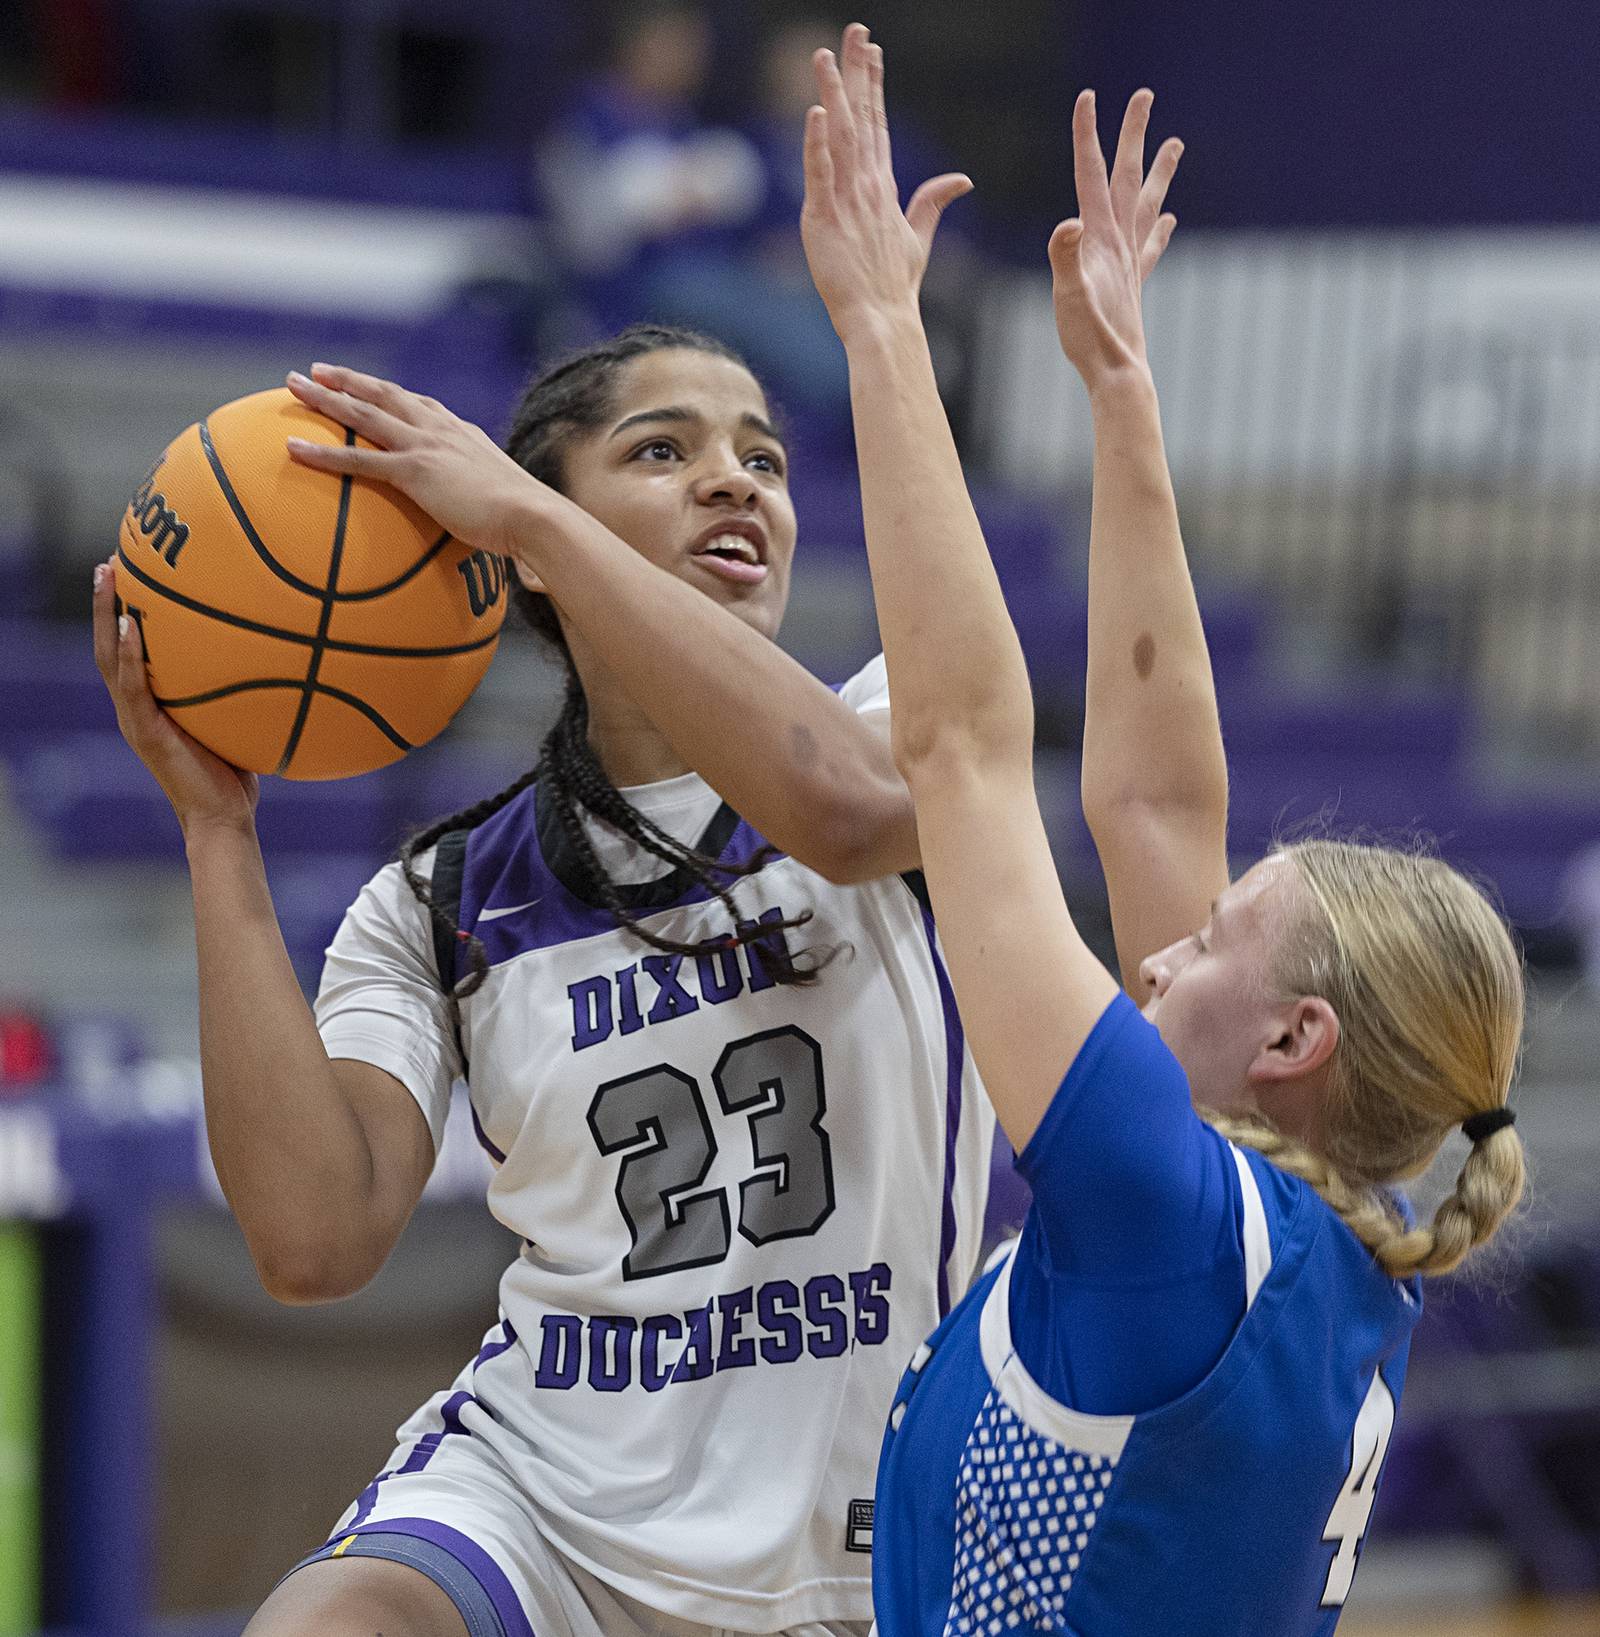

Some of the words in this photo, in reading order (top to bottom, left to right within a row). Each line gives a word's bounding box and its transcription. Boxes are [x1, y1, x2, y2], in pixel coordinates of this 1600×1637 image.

[567, 906, 794, 1052] DIXON
[586, 1023, 837, 1282] 23
[1320, 1363, 1396, 1608] 4
